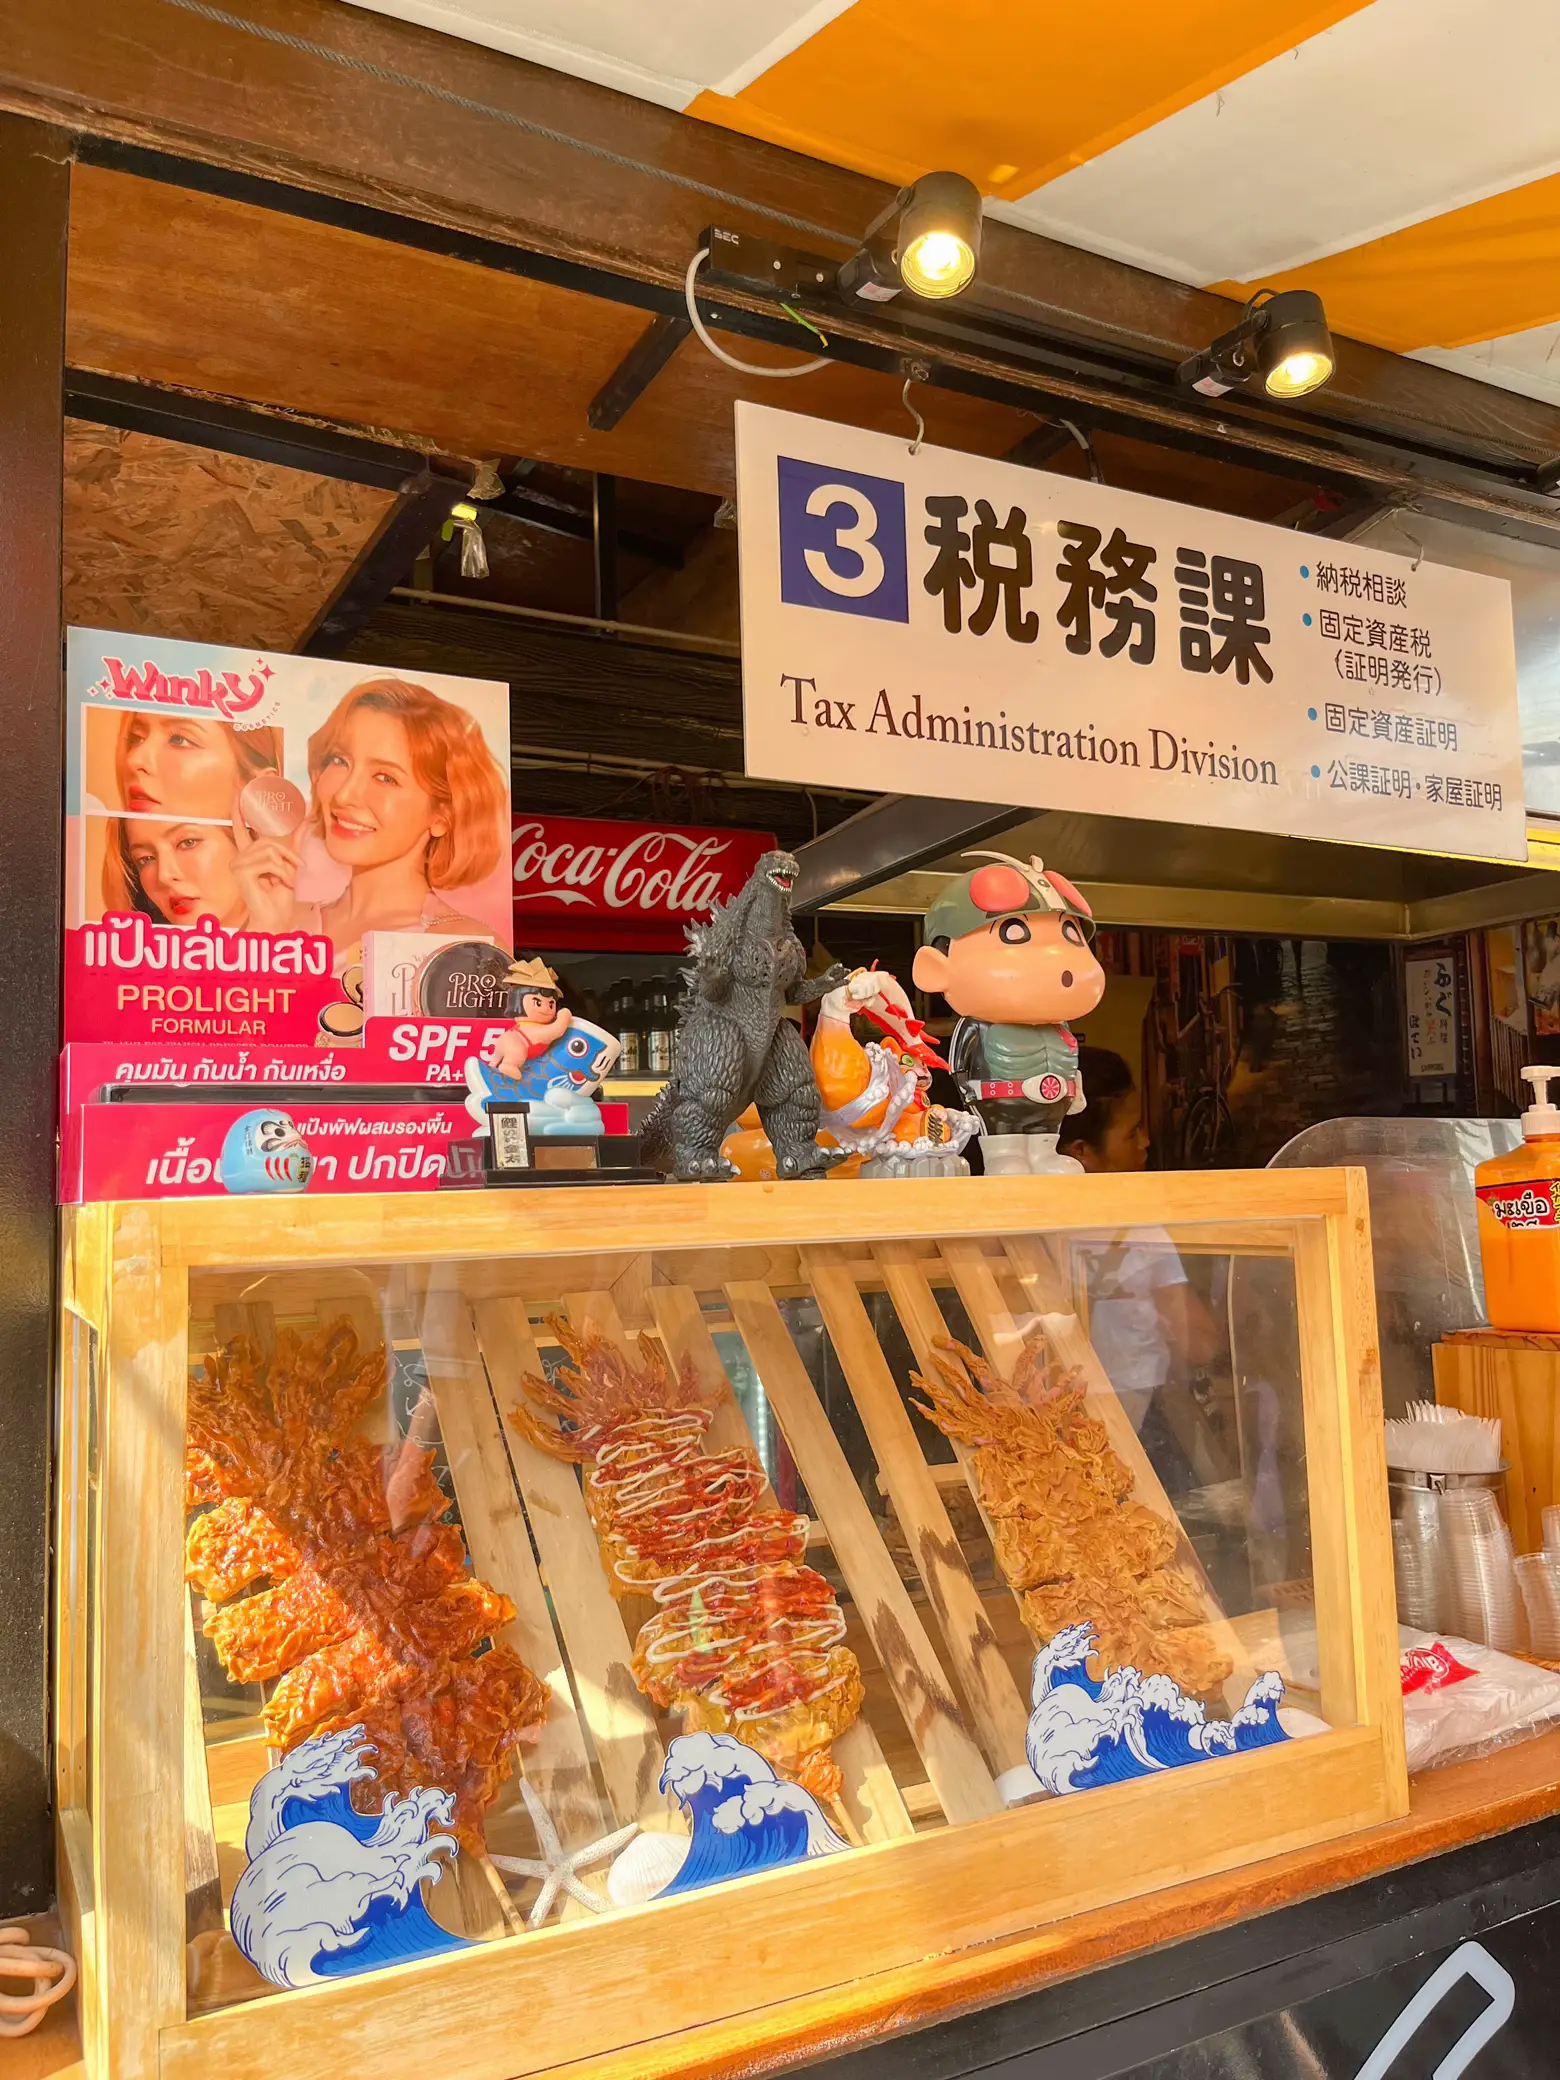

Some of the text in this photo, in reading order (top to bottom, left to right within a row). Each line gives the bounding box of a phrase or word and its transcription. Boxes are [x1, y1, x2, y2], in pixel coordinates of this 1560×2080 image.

[803, 483, 885, 598] 3
[923, 495, 1274, 685] 税務課
[1316, 561, 1407, 609] 納税相談
[1319, 609, 1432, 659] 固定資産税
[103, 657, 265, 719] Winky
[780, 673, 1279, 786] Tax Administration Division
[1325, 702, 1458, 752] 固定資産証明
[85, 917, 326, 975] แป้งเล่นแสง
[117, 984, 296, 1014] PROLIGHT
[151, 1018, 266, 1036] FORMULAR
[389, 1024, 472, 1061] SPF
[115, 1051, 346, 1083] คุมมัน กันน้ำ กันเหงื่อ
[348, 1145, 447, 1180] ปกปิด
[1494, 1191, 1548, 1218] มะเขือ
